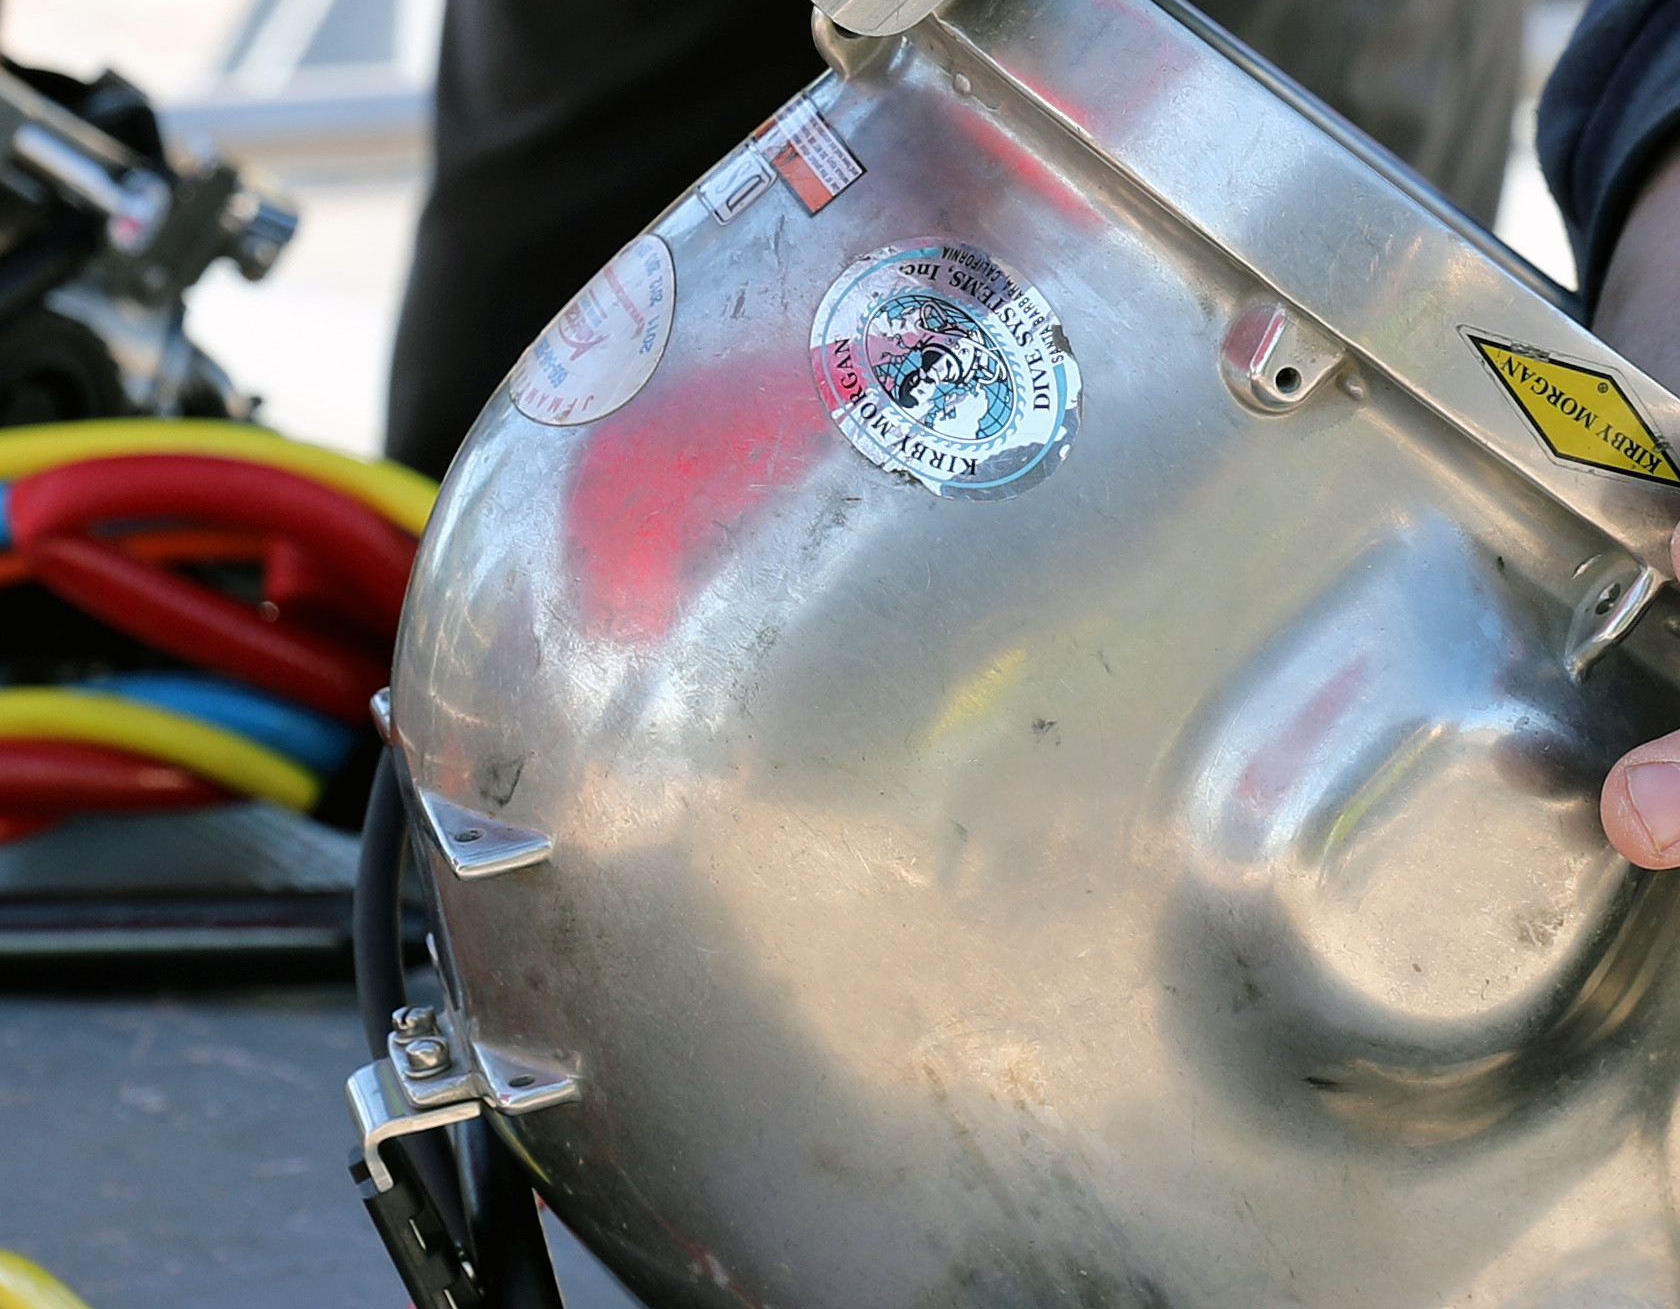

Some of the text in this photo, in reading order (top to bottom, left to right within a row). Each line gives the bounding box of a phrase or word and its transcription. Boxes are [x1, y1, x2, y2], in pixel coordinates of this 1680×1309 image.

[898, 263, 941, 281] Inc.
[940, 245, 1003, 282] CALIFORNIA
[639, 315, 660, 355] 2011
[1040, 326, 1065, 364] SANTA
[1024, 353, 1051, 411] DIVE
[834, 338, 978, 476] KIRBY MORGAN
[1500, 355, 1664, 474] KIRBY MORGAN
